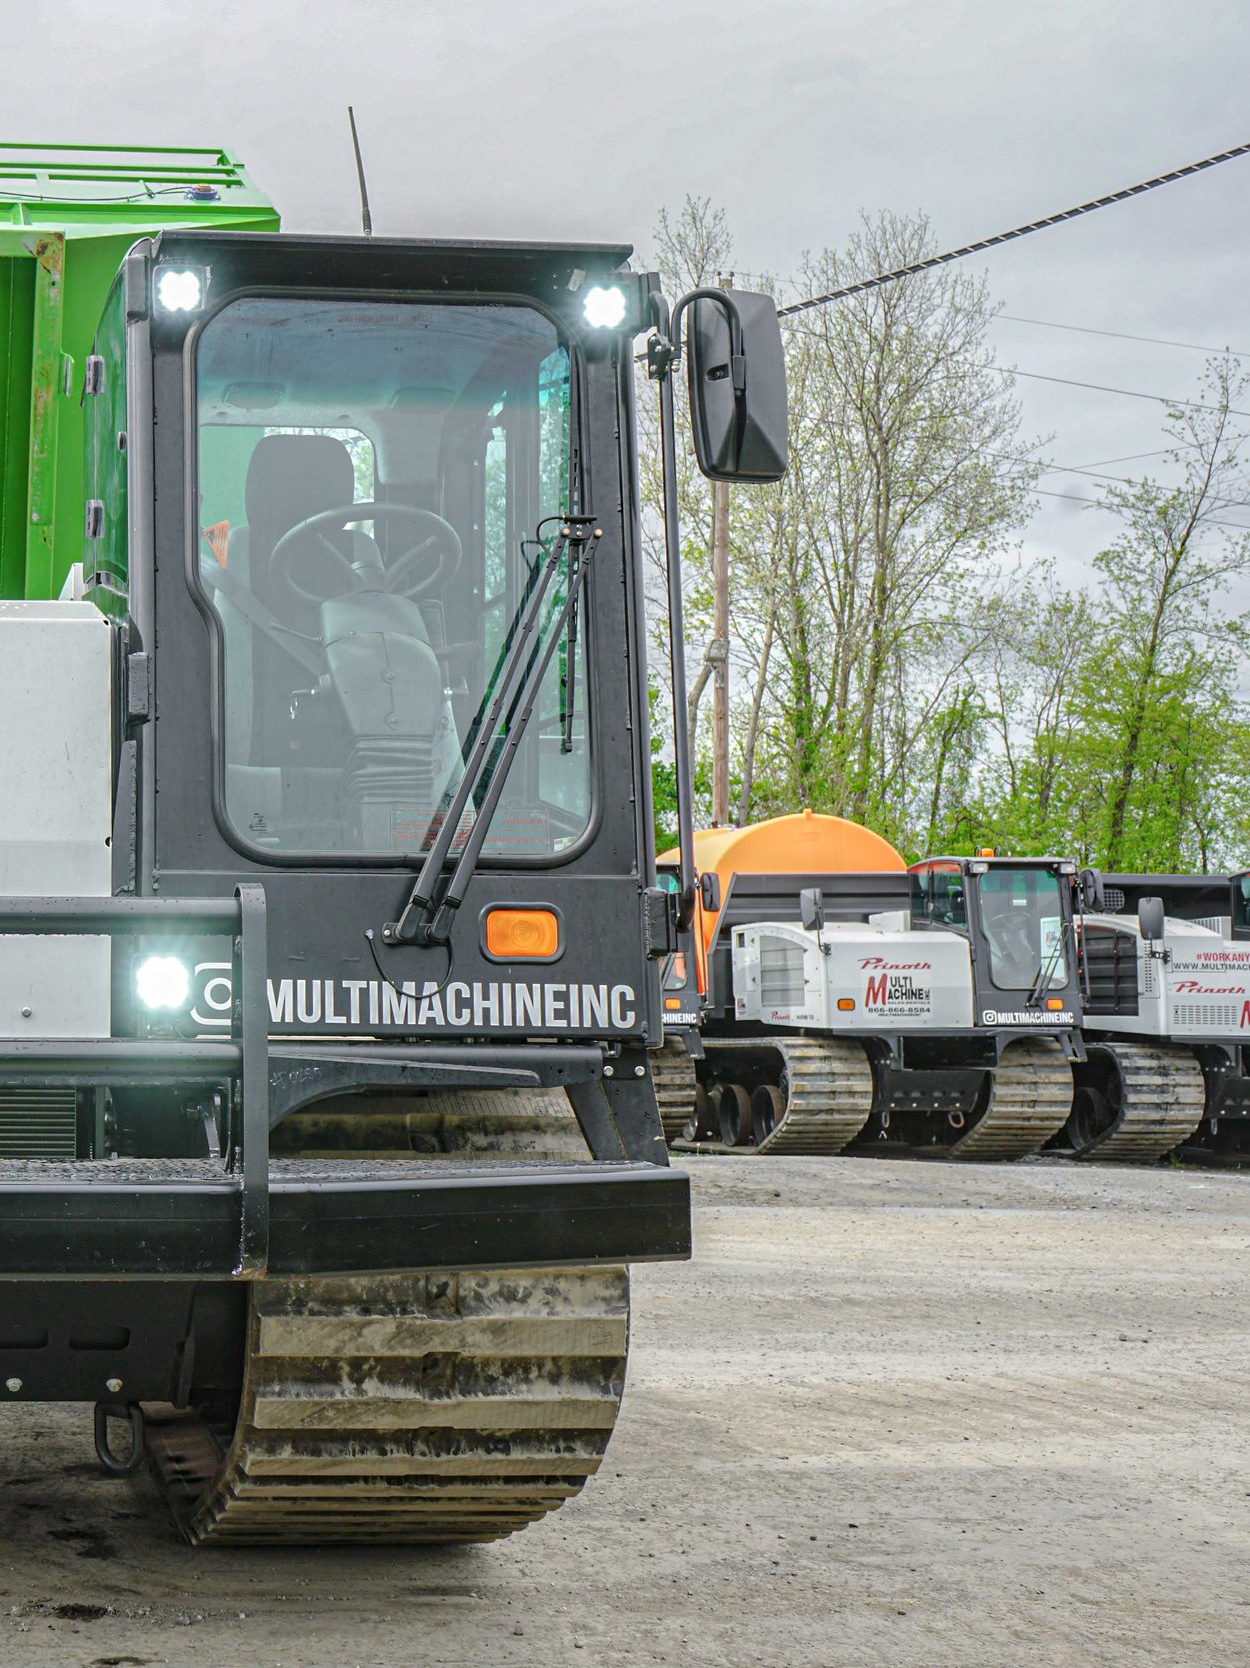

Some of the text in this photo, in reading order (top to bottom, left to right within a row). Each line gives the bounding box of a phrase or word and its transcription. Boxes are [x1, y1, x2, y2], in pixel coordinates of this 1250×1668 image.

[857, 957, 932, 970] Prinoth
[1173, 981, 1246, 994] Prinoth
[267, 978, 636, 1028] MULTIMACHINEINC
[997, 1012, 1074, 1024] MULTIMACHINEINC
